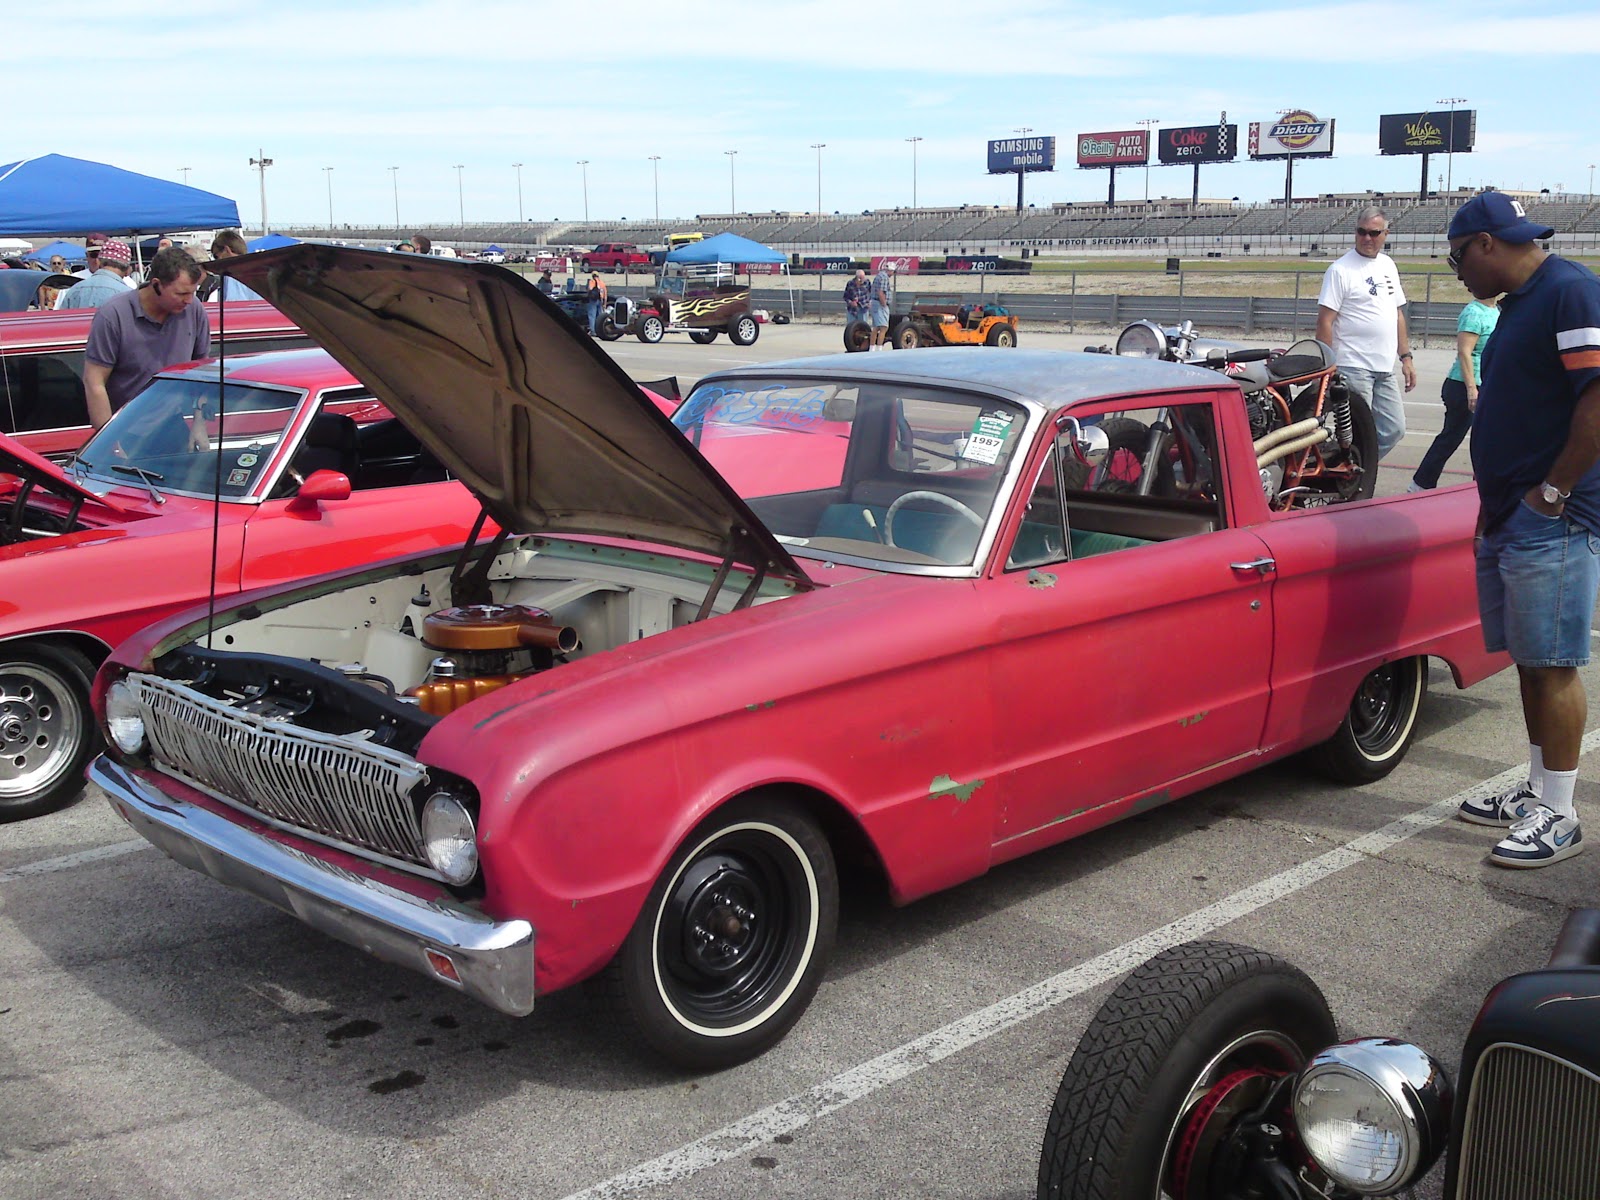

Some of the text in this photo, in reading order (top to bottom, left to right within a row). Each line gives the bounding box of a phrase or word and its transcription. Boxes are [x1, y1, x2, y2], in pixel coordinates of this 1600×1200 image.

[1274, 125, 1321, 135] Dickies
[1119, 135, 1141, 146] AUTO
[1170, 129, 1208, 146] Coke
[993, 138, 1044, 153] SAMSUNG
[1080, 138, 1116, 158] O'Reilly
[1116, 146, 1143, 156] PARTS
[1013, 152, 1043, 165] mobile
[1058, 238, 1087, 246] MOTOR
[826, 262, 849, 271] zero
[946, 259, 997, 271] Coke zero
[971, 436, 1001, 447] 1987
